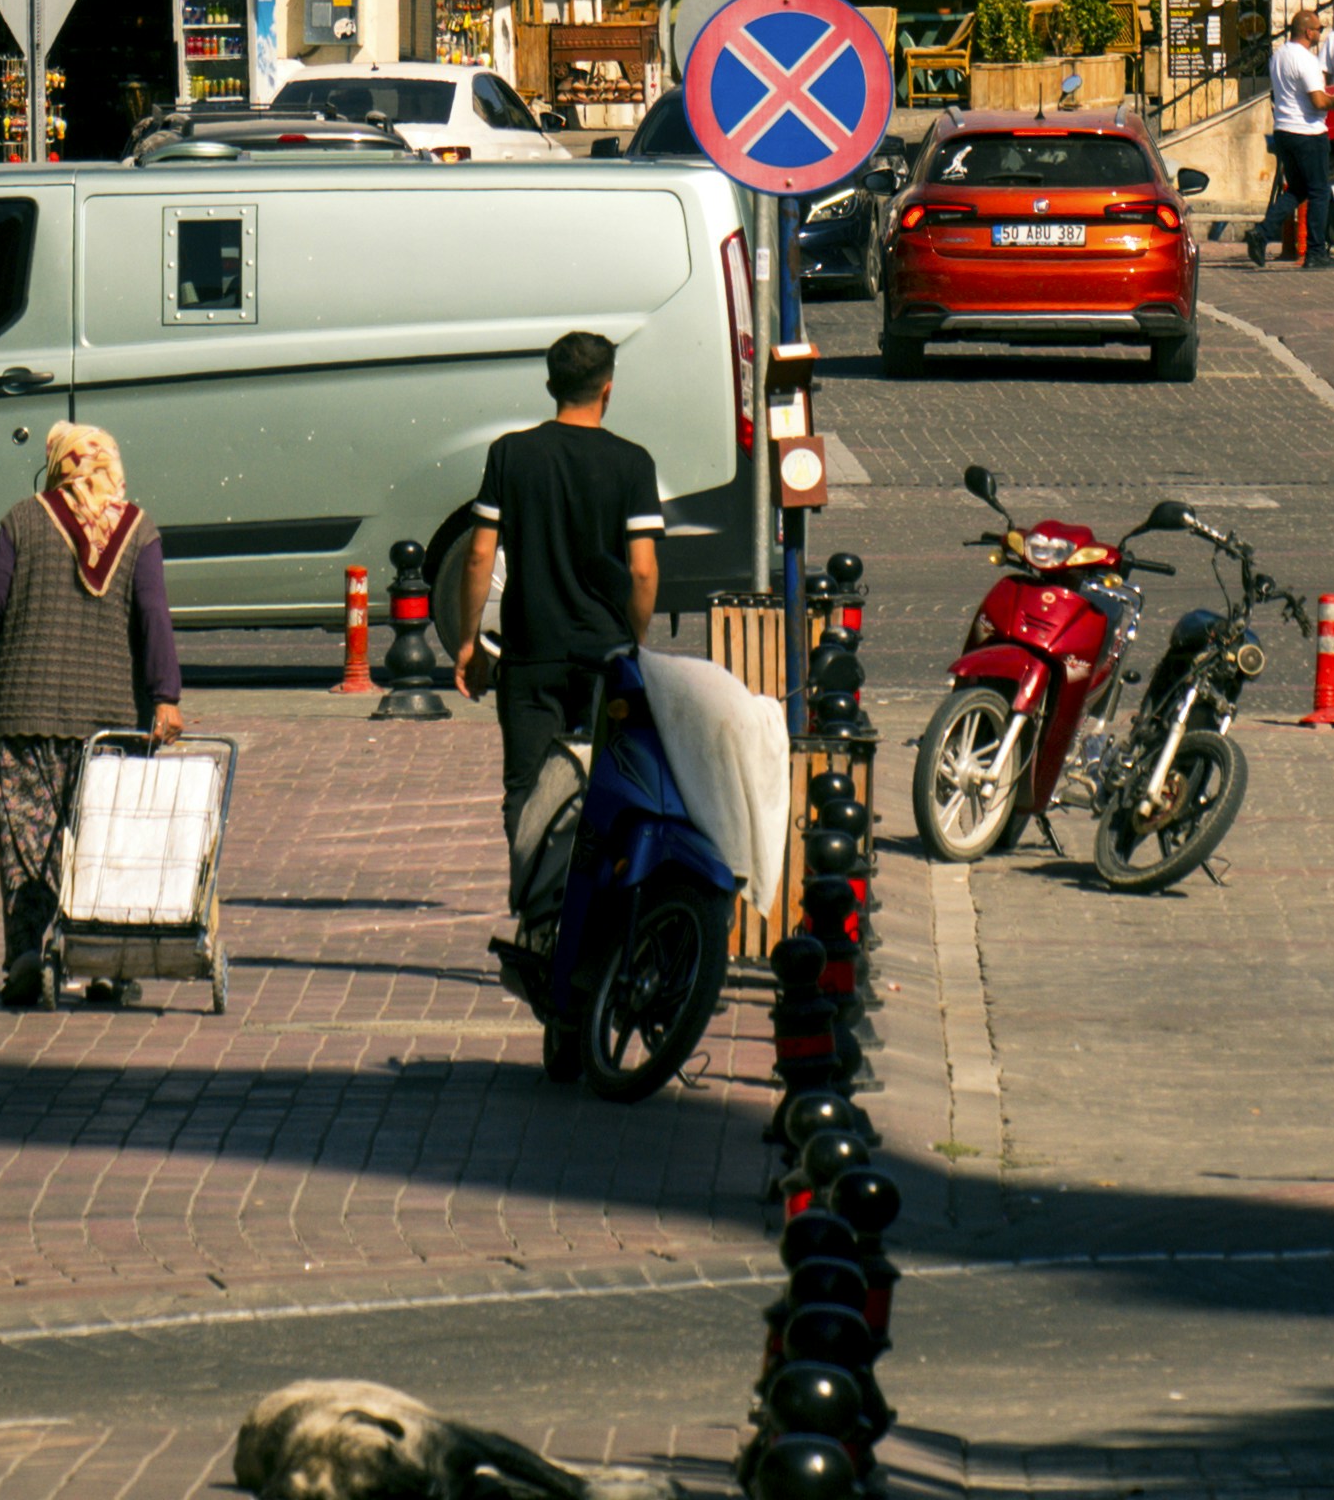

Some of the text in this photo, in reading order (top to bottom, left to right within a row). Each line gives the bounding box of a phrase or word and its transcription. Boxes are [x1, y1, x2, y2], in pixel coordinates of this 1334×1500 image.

[1002, 225, 1084, 241] 50 ABU 387
